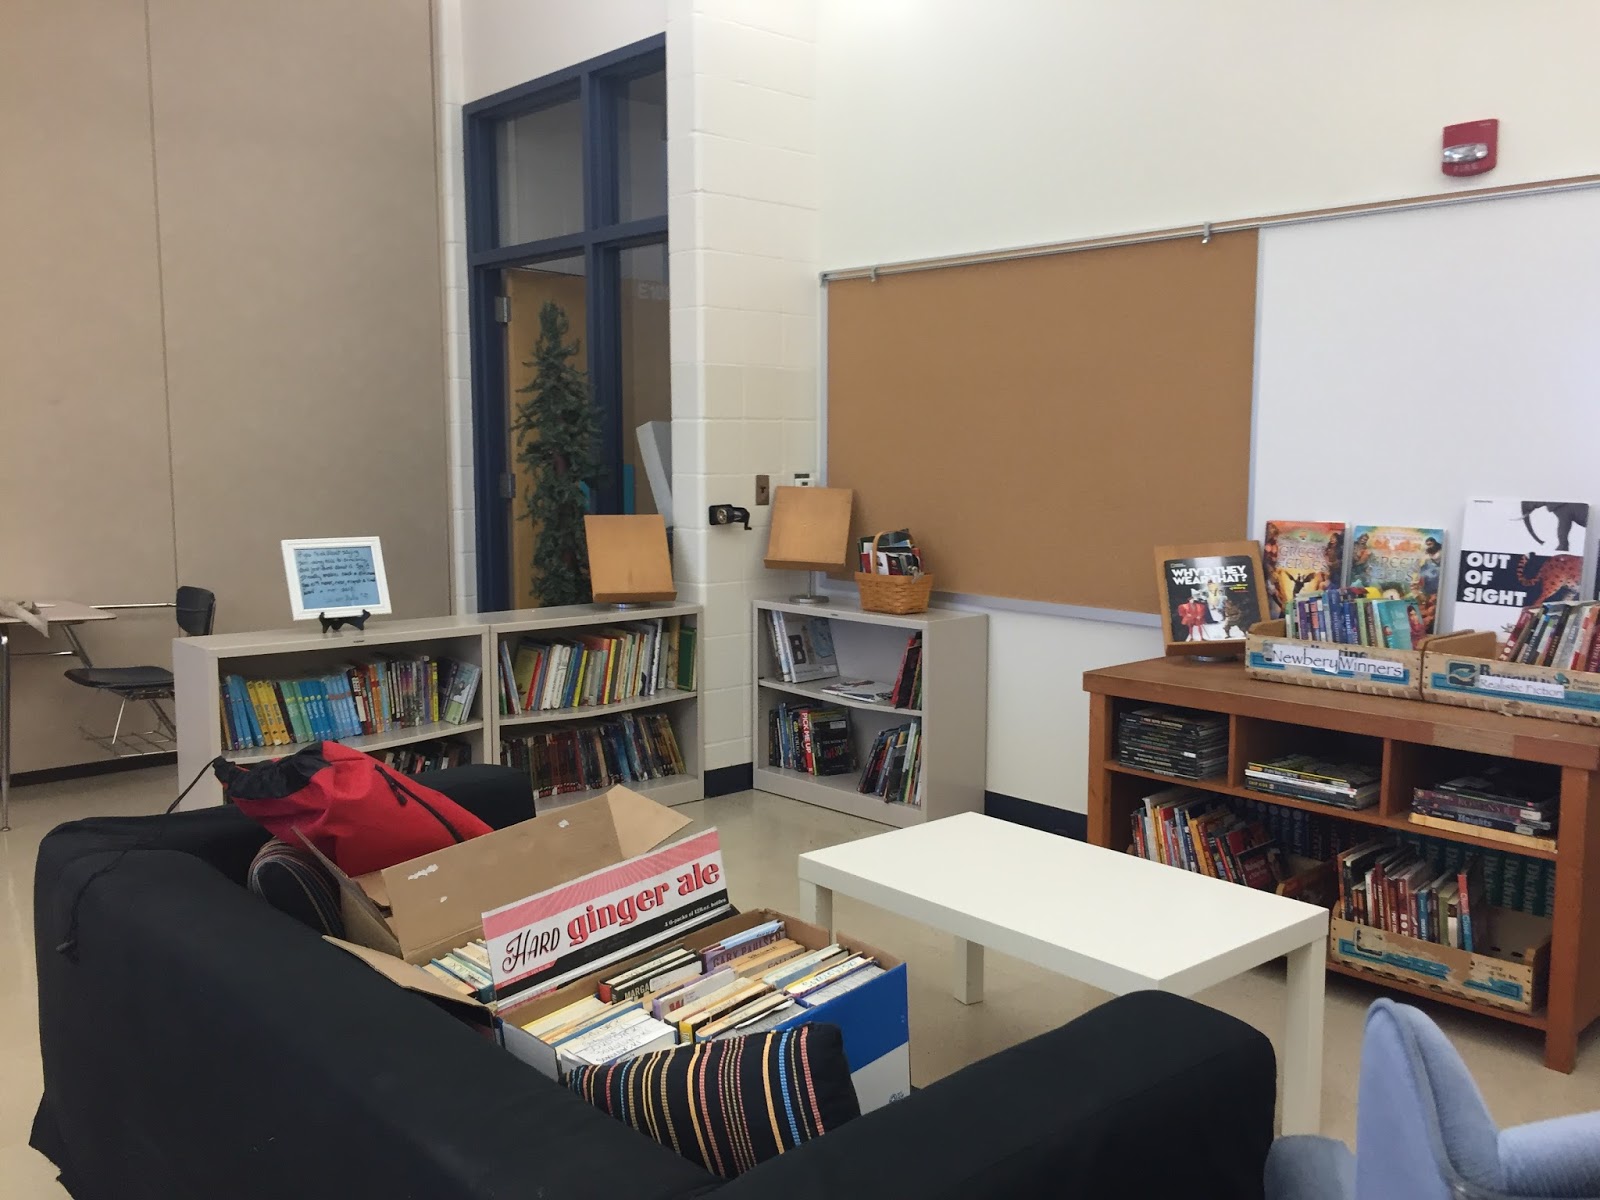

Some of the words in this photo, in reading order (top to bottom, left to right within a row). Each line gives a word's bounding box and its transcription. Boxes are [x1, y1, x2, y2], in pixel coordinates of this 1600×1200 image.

[1466, 552, 1511, 569] OUT
[1171, 567, 1212, 577] WHY'D
[1216, 565, 1246, 575] THEY
[1173, 576, 1210, 585] WEAR
[1210, 573, 1248, 584] THAT?
[1465, 570, 1494, 585] OF
[1463, 587, 1527, 606] SIGHT
[1272, 649, 1339, 671] Newbery
[1338, 656, 1402, 676] Winners
[1480, 676, 1524, 693] Realistic
[1526, 684, 1564, 697] Fiction
[801, 712, 809, 729] PICK
[804, 730, 811, 742] ME
[805, 743, 811, 753] UP
[502, 927, 560, 973] HARD
[567, 882, 669, 947] ginger
[677, 862, 720, 896] ale
[712, 951, 740, 968] GARY
[740, 931, 782, 957] PAULSEN
[624, 981, 651, 999] MARGA
